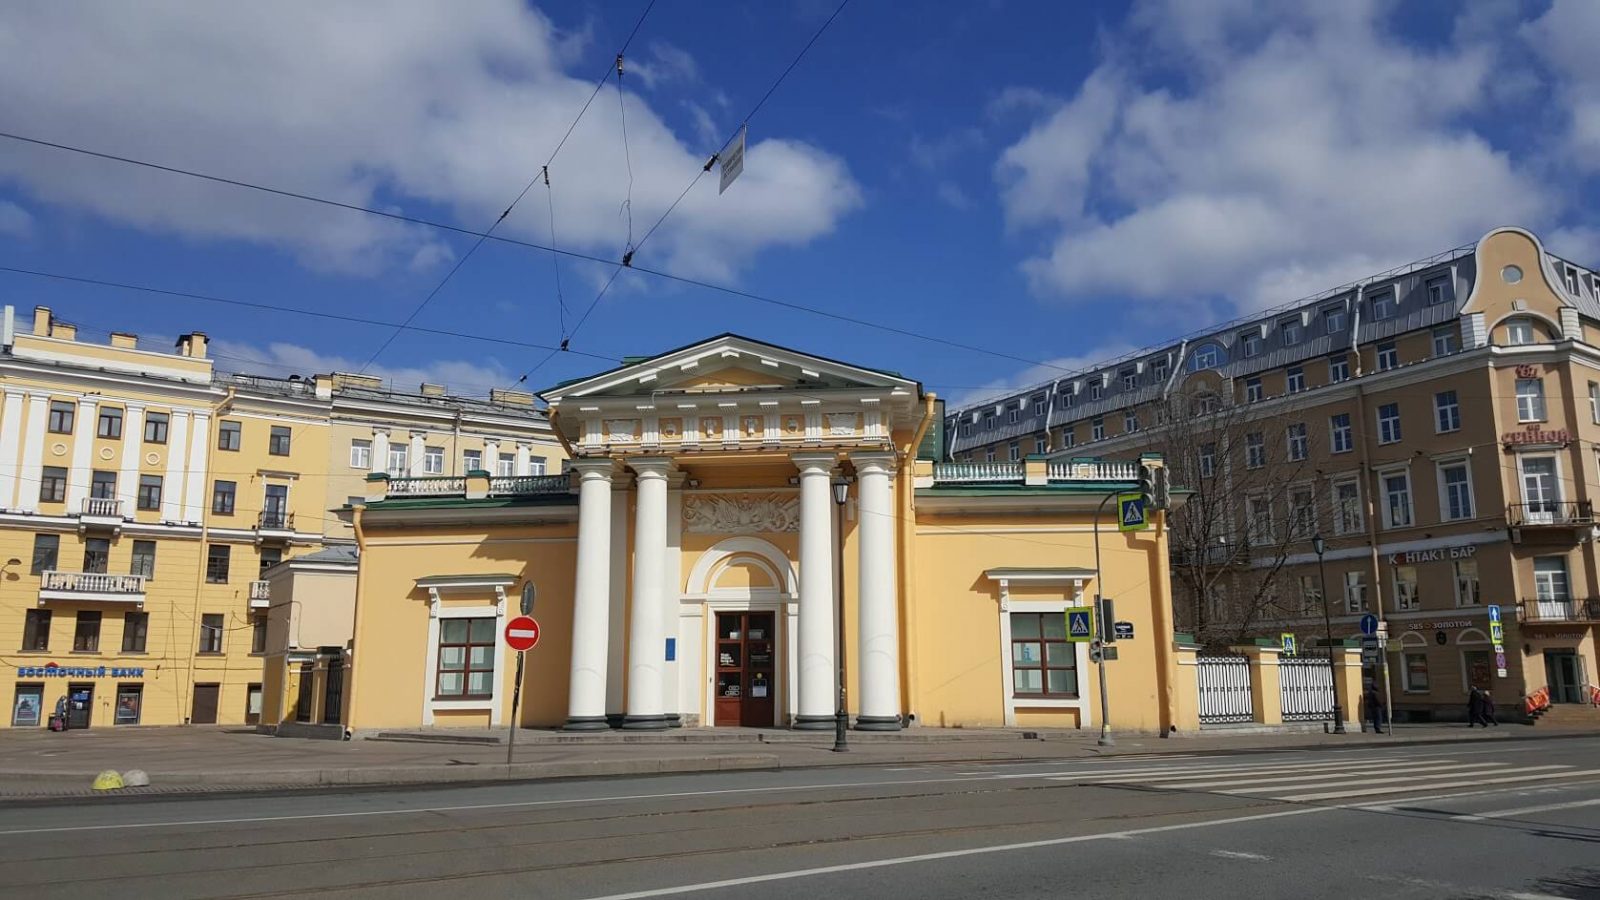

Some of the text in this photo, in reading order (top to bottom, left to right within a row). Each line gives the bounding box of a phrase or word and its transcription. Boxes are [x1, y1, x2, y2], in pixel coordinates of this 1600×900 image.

[1450, 546, 1476, 559] БАР
[17, 664, 144, 678] ВОСТОЧНЫЙ БАНК
